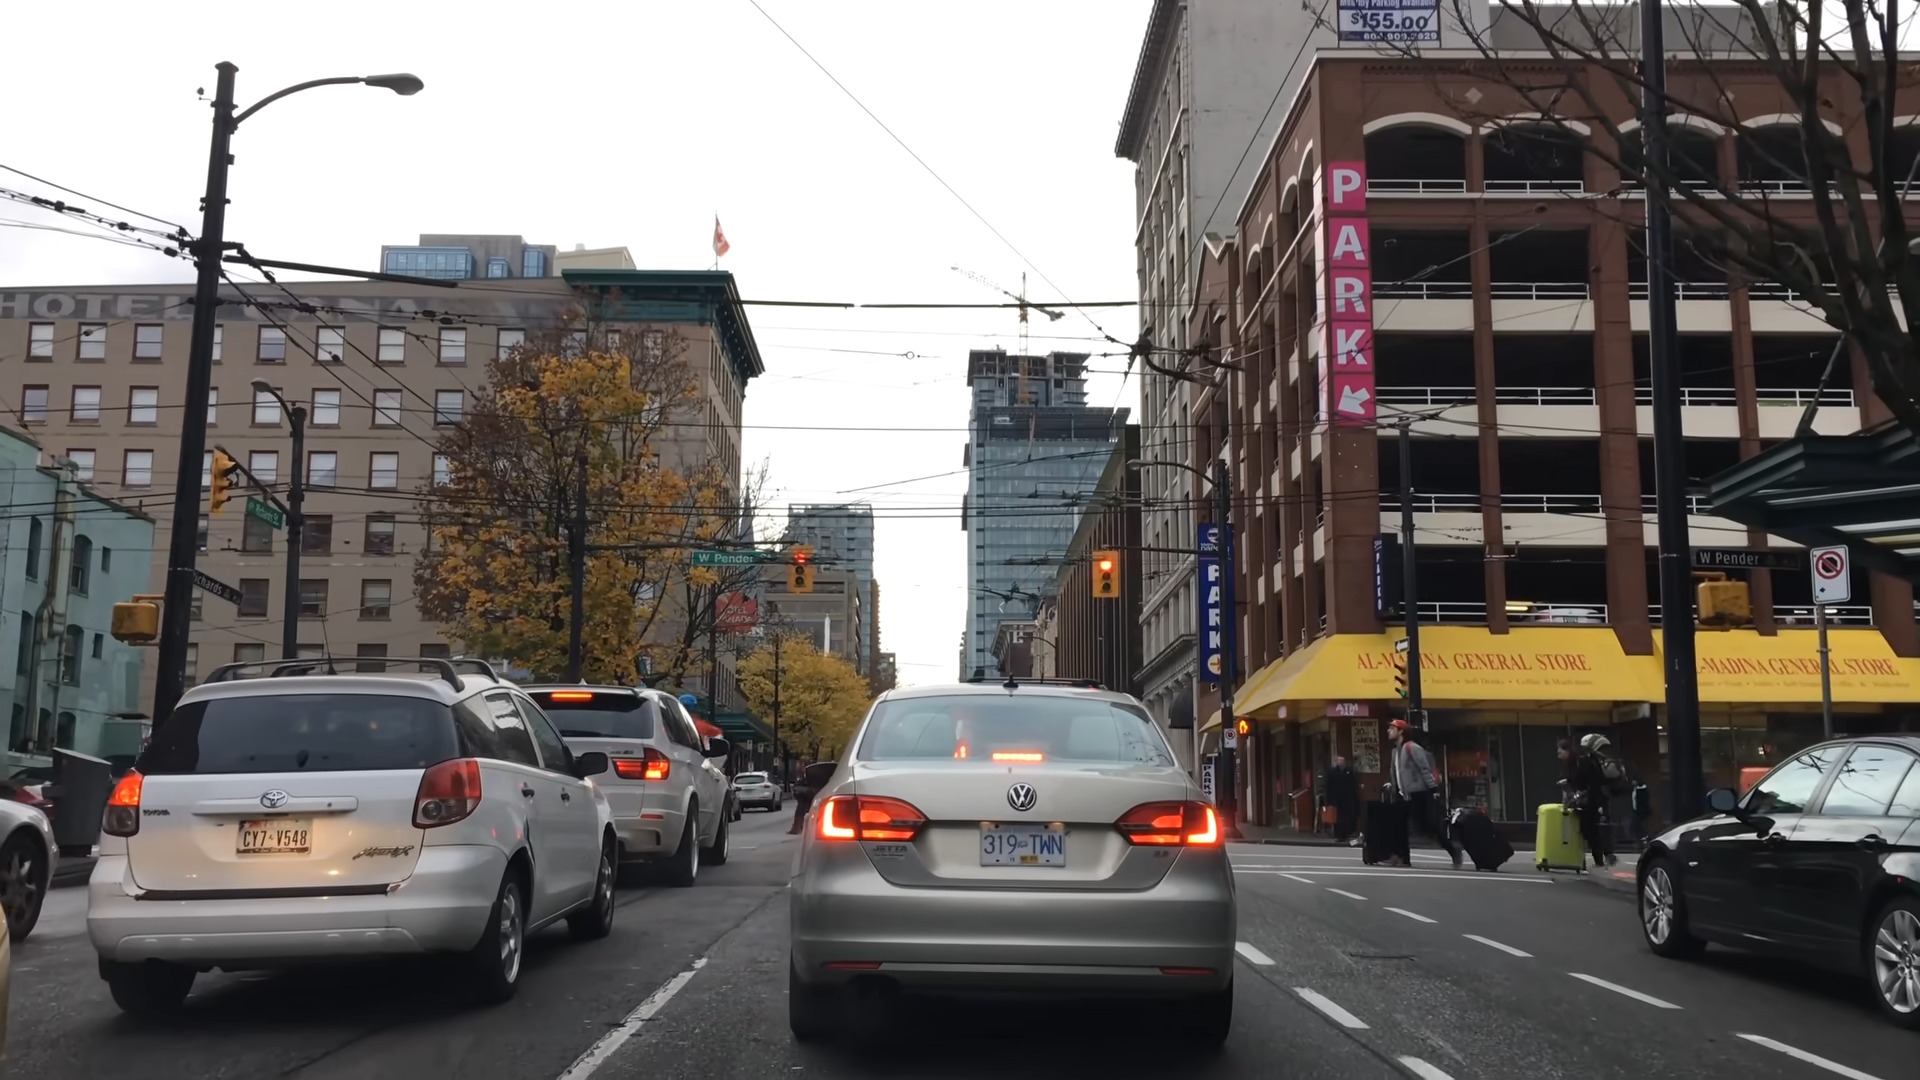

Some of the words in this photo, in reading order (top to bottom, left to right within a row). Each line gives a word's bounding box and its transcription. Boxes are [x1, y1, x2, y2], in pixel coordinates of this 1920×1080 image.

[1350, 12, 1429, 30] $155.00
[1332, 168, 1368, 365] PARK
[0, 291, 193, 319] HOTEL
[698, 553, 709, 563] W
[714, 553, 754, 563] Pender
[1700, 552, 1711, 564] W
[1715, 552, 1759, 565] Pender
[193, 572, 223, 595] ichards
[1453, 652, 1532, 671] GENERAL
[1536, 653, 1592, 671] STORE
[1843, 658, 1900, 676] STORE
[1335, 702, 1359, 712] ATM
[1203, 765, 1212, 790] PARK
[243, 829, 267, 847] CY7
[276, 829, 307, 847] V548
[983, 834, 1018, 855] 319
[1028, 834, 1063, 855] TWN
